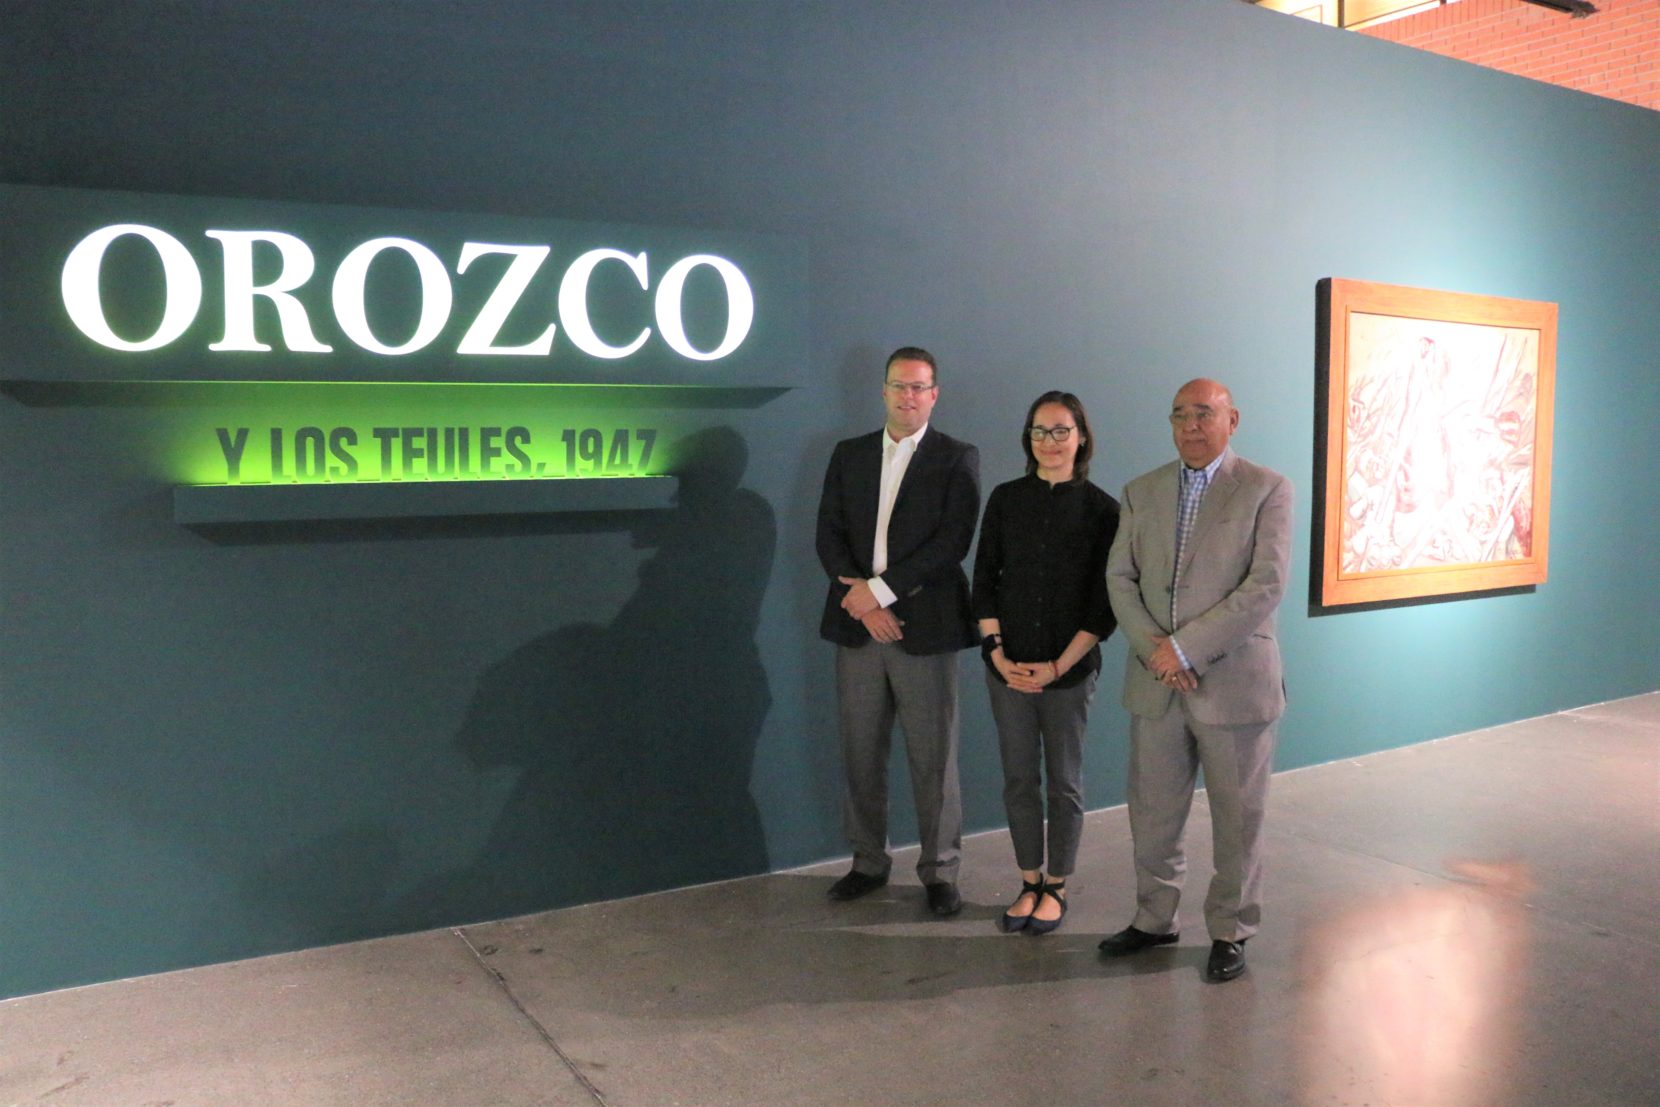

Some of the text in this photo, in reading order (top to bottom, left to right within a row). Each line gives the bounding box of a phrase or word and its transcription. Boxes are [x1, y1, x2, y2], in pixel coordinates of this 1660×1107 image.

[61, 224, 754, 361] OROZCO
[215, 426, 657, 484] Y LOS TEULES, 1947
